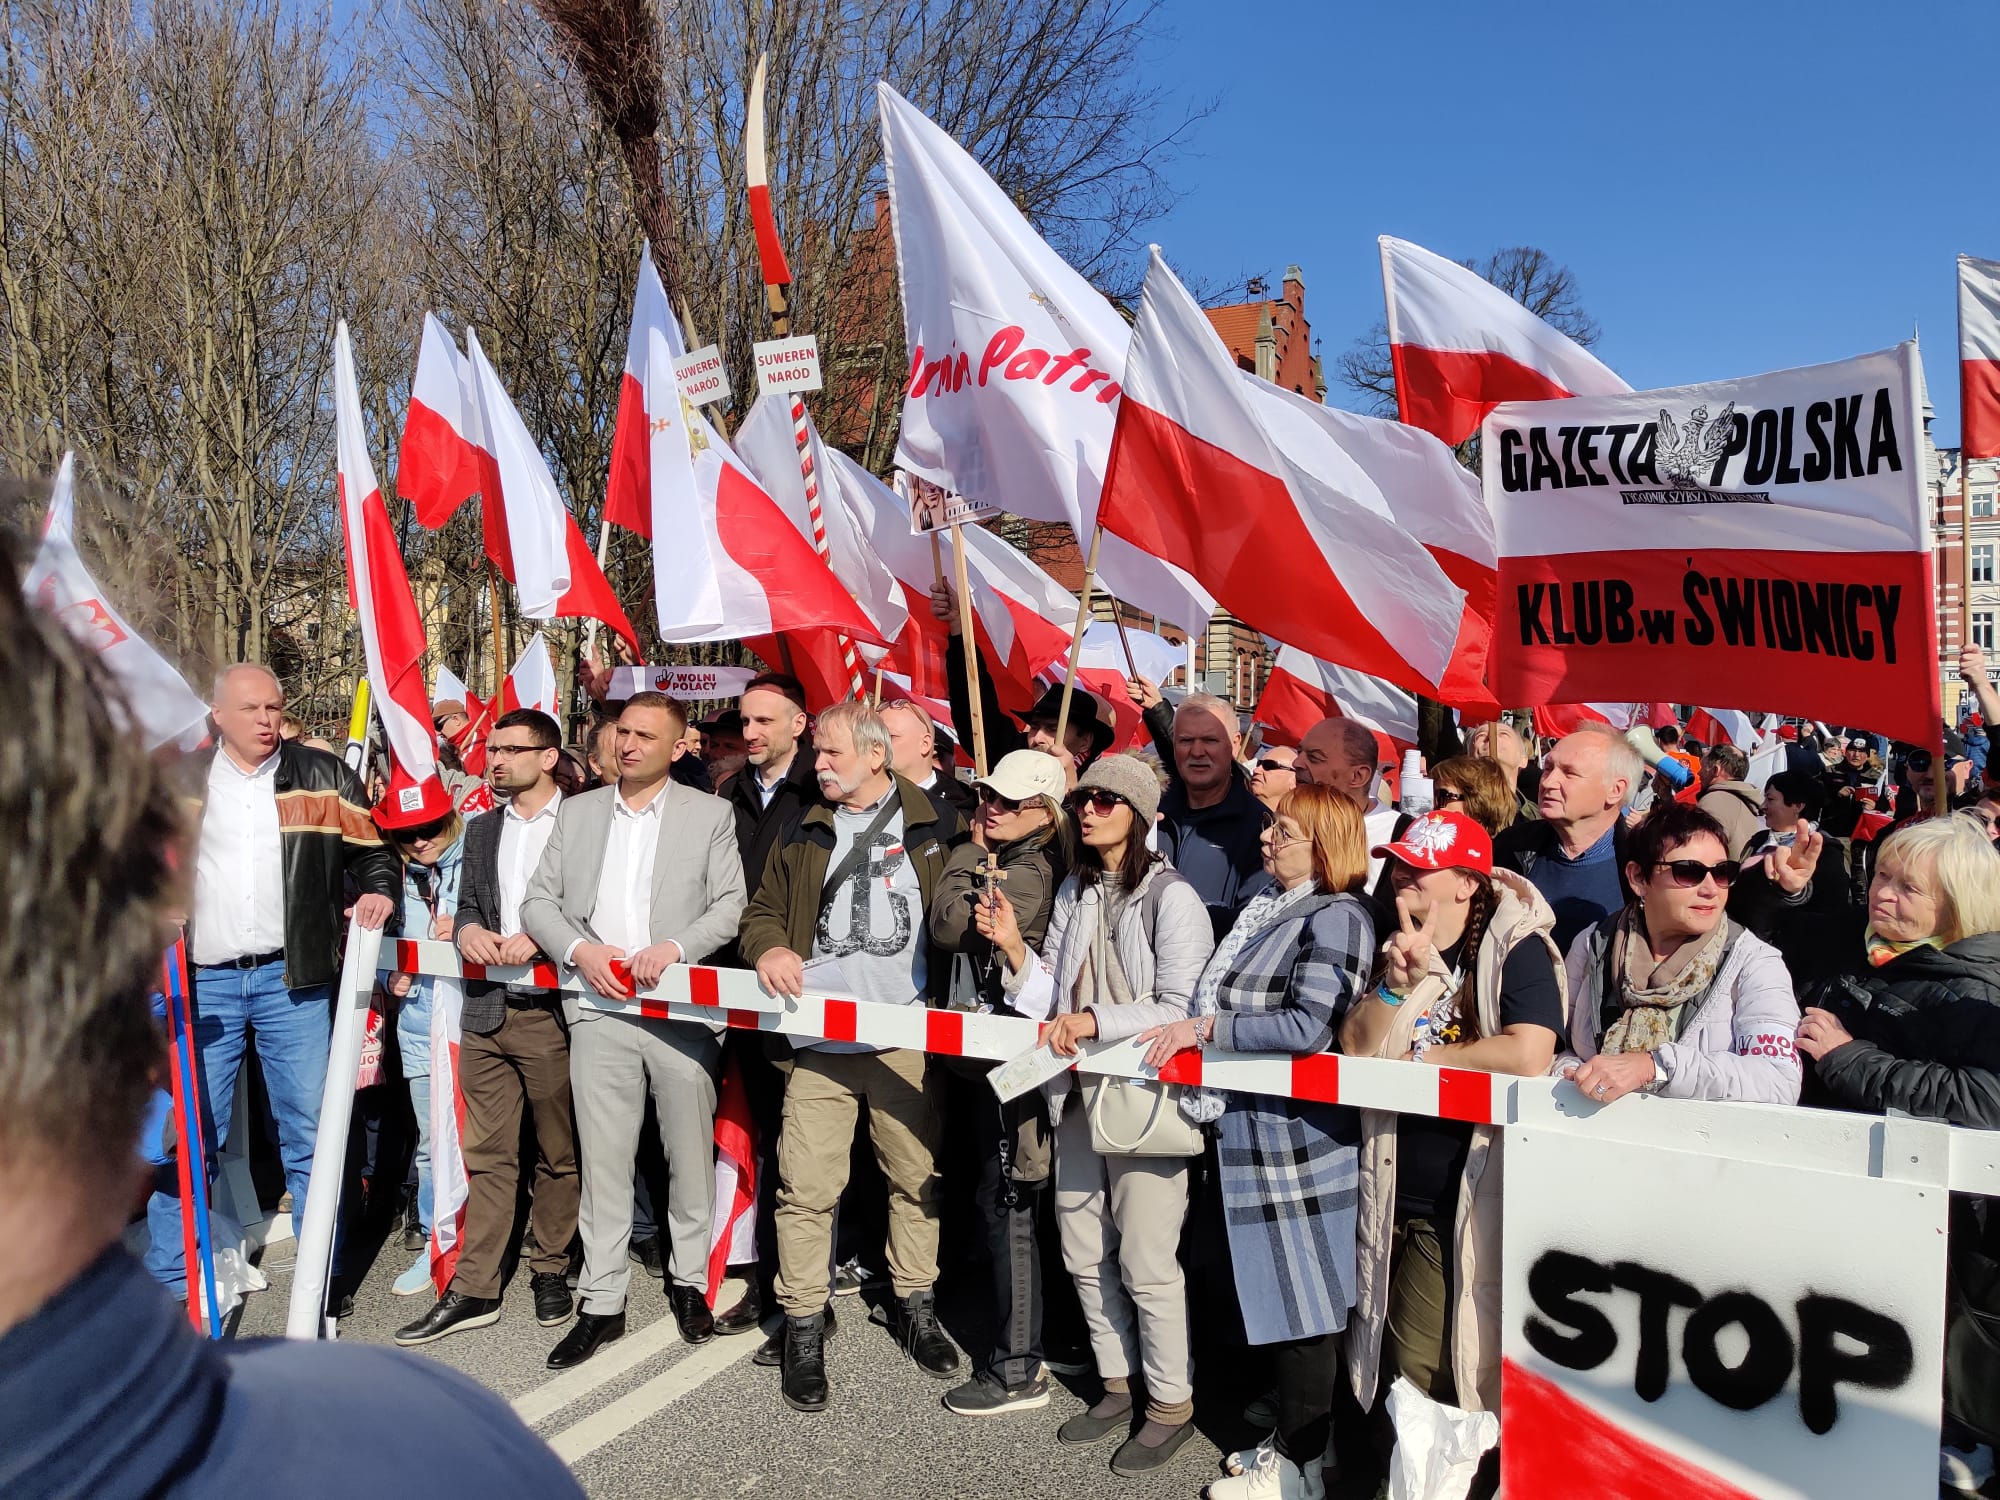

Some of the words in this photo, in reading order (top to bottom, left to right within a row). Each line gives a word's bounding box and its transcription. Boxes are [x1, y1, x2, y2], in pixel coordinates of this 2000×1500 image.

[758, 347, 816, 367] SUWEREN
[675, 356, 721, 381] SUWEREN
[767, 366, 811, 384] NARÓD
[686, 376, 720, 396] NARÓD
[1500, 421, 1664, 493] GAZETA
[1709, 387, 1903, 487] POLSKA
[1622, 491, 1668, 504] TYGODNIK
[1669, 491, 1708, 503] SZYBSZY
[1516, 579, 1635, 647] KLUB
[1682, 556, 1902, 665] ŚWIDNICY
[672, 682, 717, 691] POLACY
[676, 673, 716, 681] WOLNI
[1523, 1249, 1914, 1436] STOP
